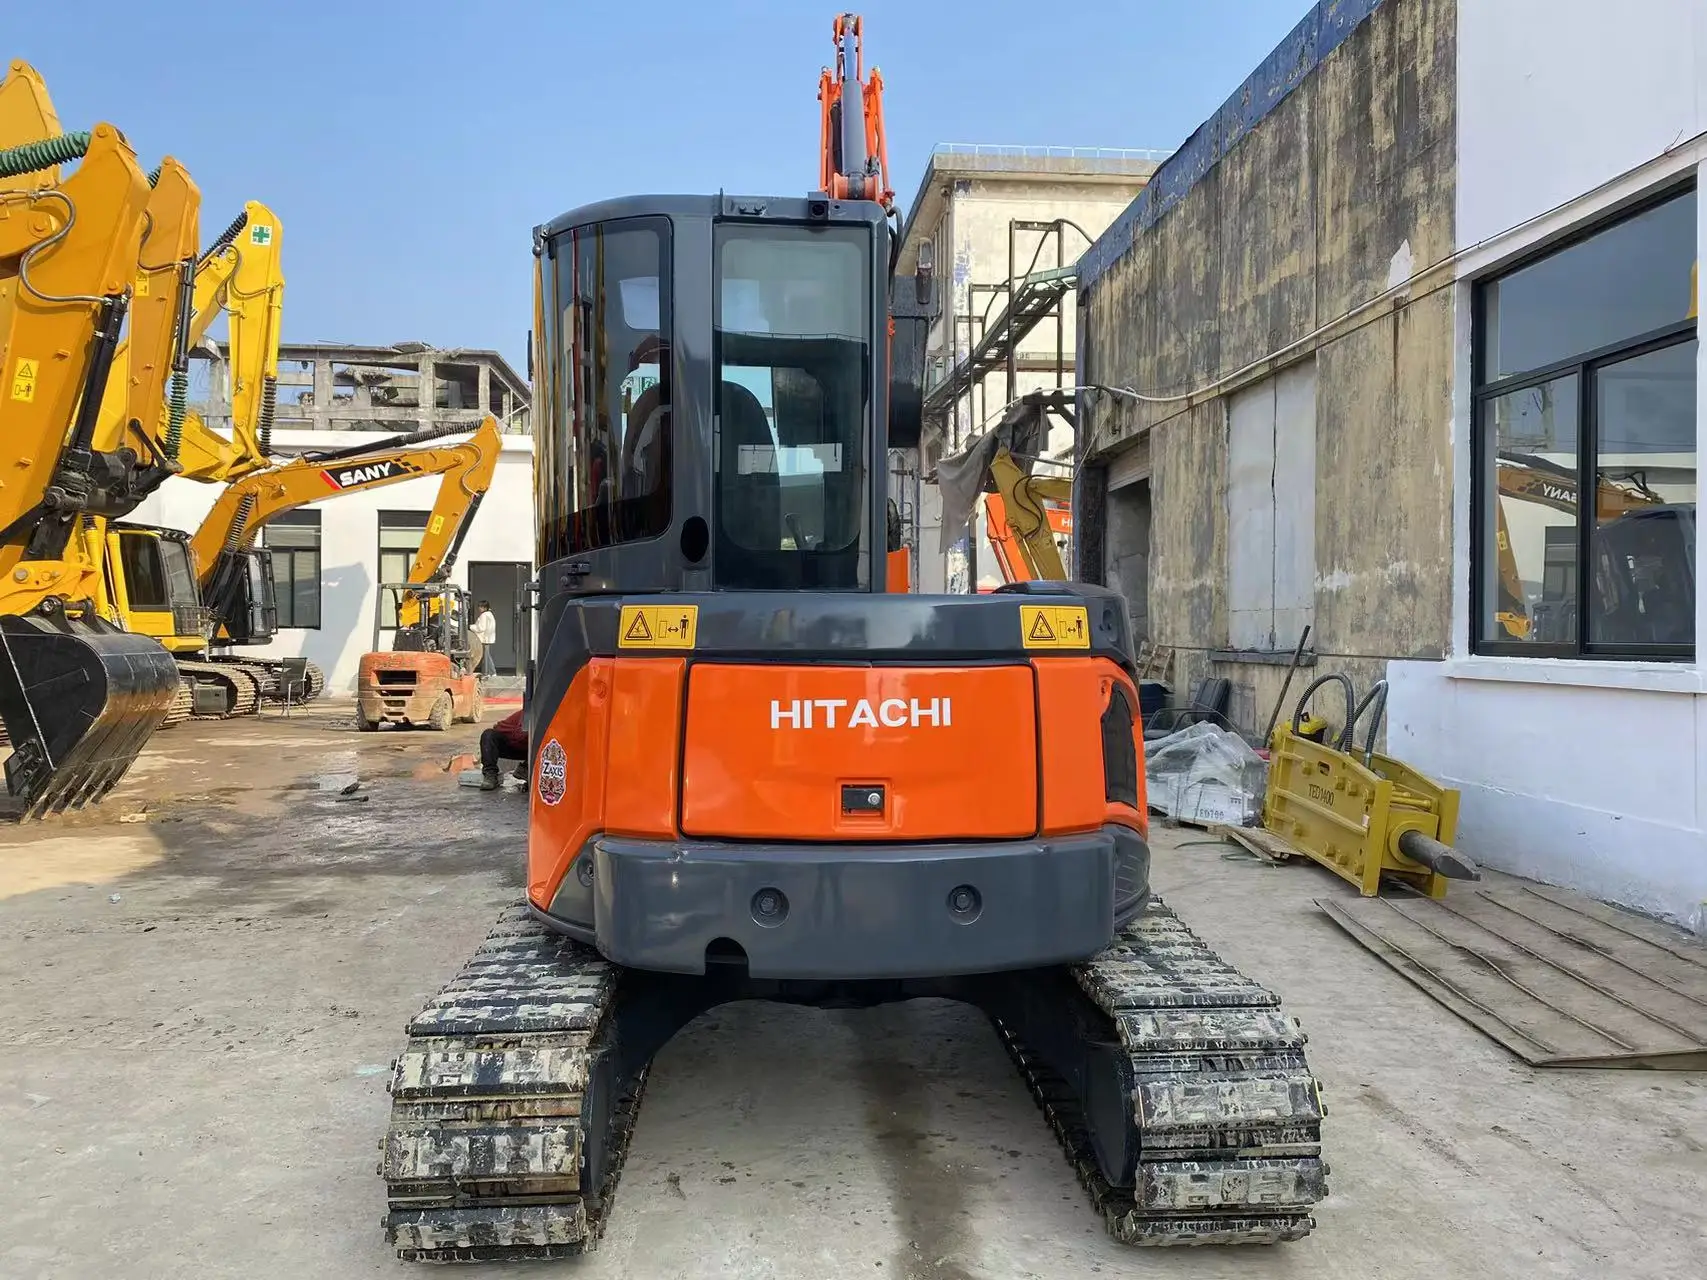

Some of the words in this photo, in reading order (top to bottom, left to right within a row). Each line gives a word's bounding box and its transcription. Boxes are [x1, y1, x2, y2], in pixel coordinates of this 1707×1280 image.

[340, 462, 391, 487] SANY
[770, 697, 952, 729] HITACHI
[543, 762, 564, 777] ZAXIS
